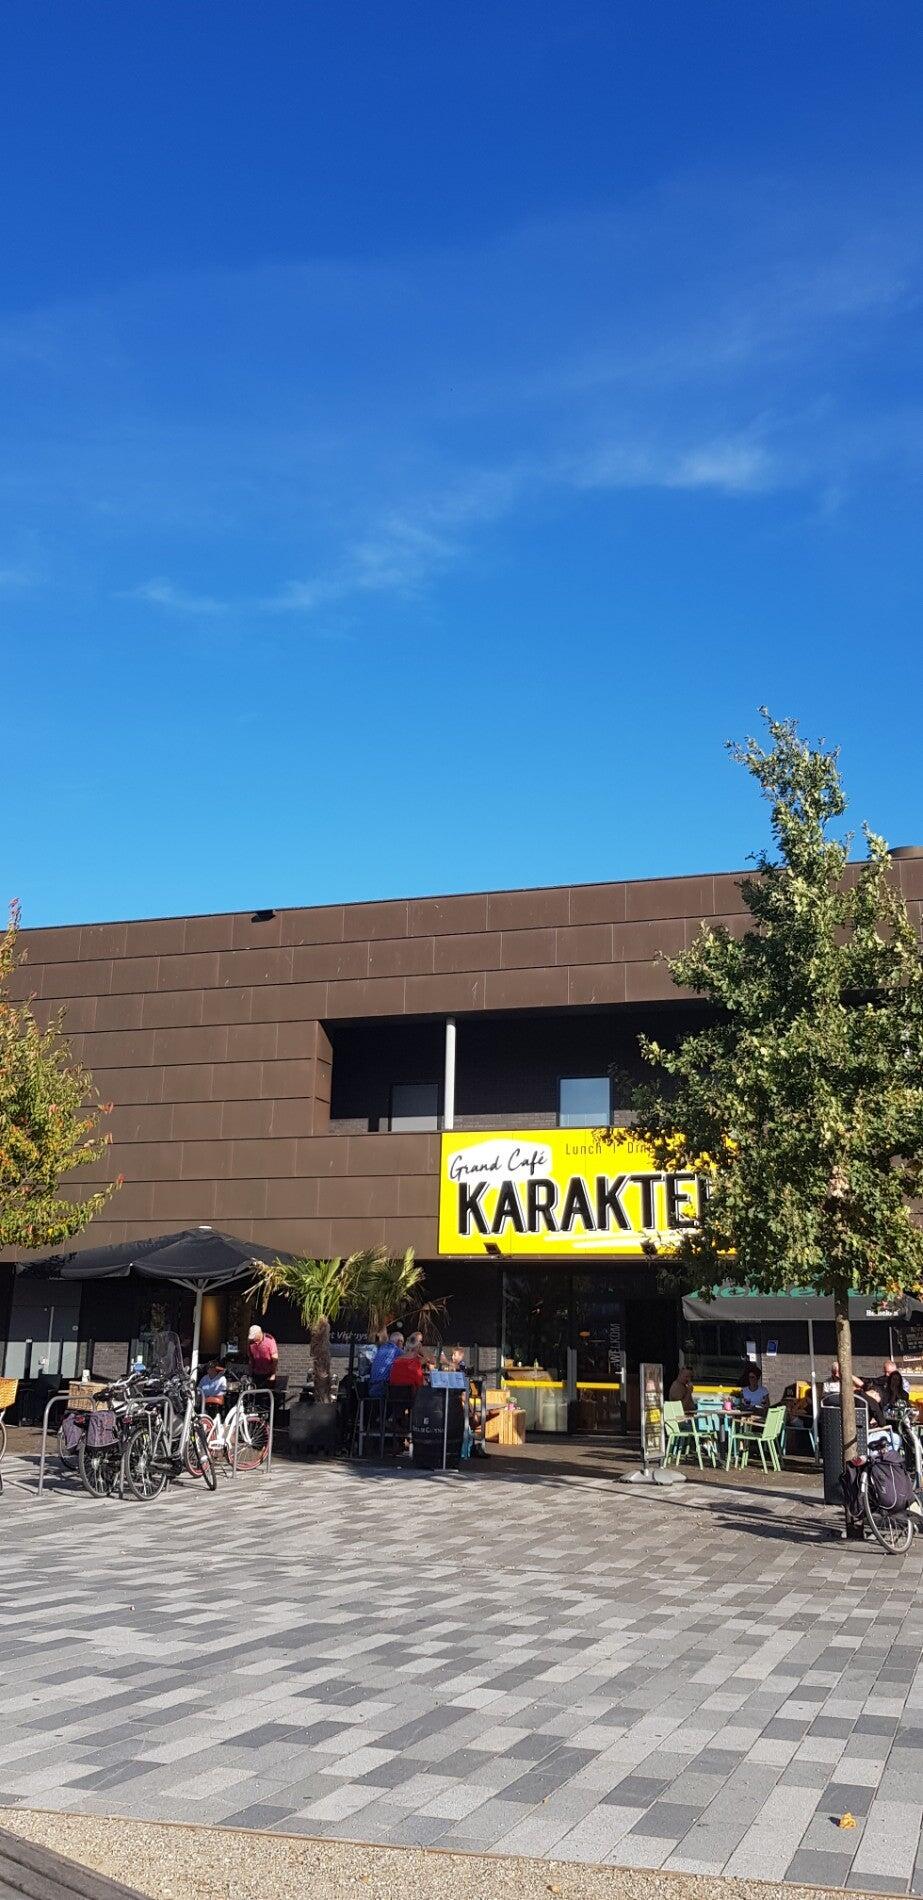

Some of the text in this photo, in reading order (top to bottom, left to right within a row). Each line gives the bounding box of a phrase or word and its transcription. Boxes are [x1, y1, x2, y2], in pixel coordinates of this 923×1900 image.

[565, 1142, 602, 1155] Lunch
[449, 1147, 548, 1181] Grand Café
